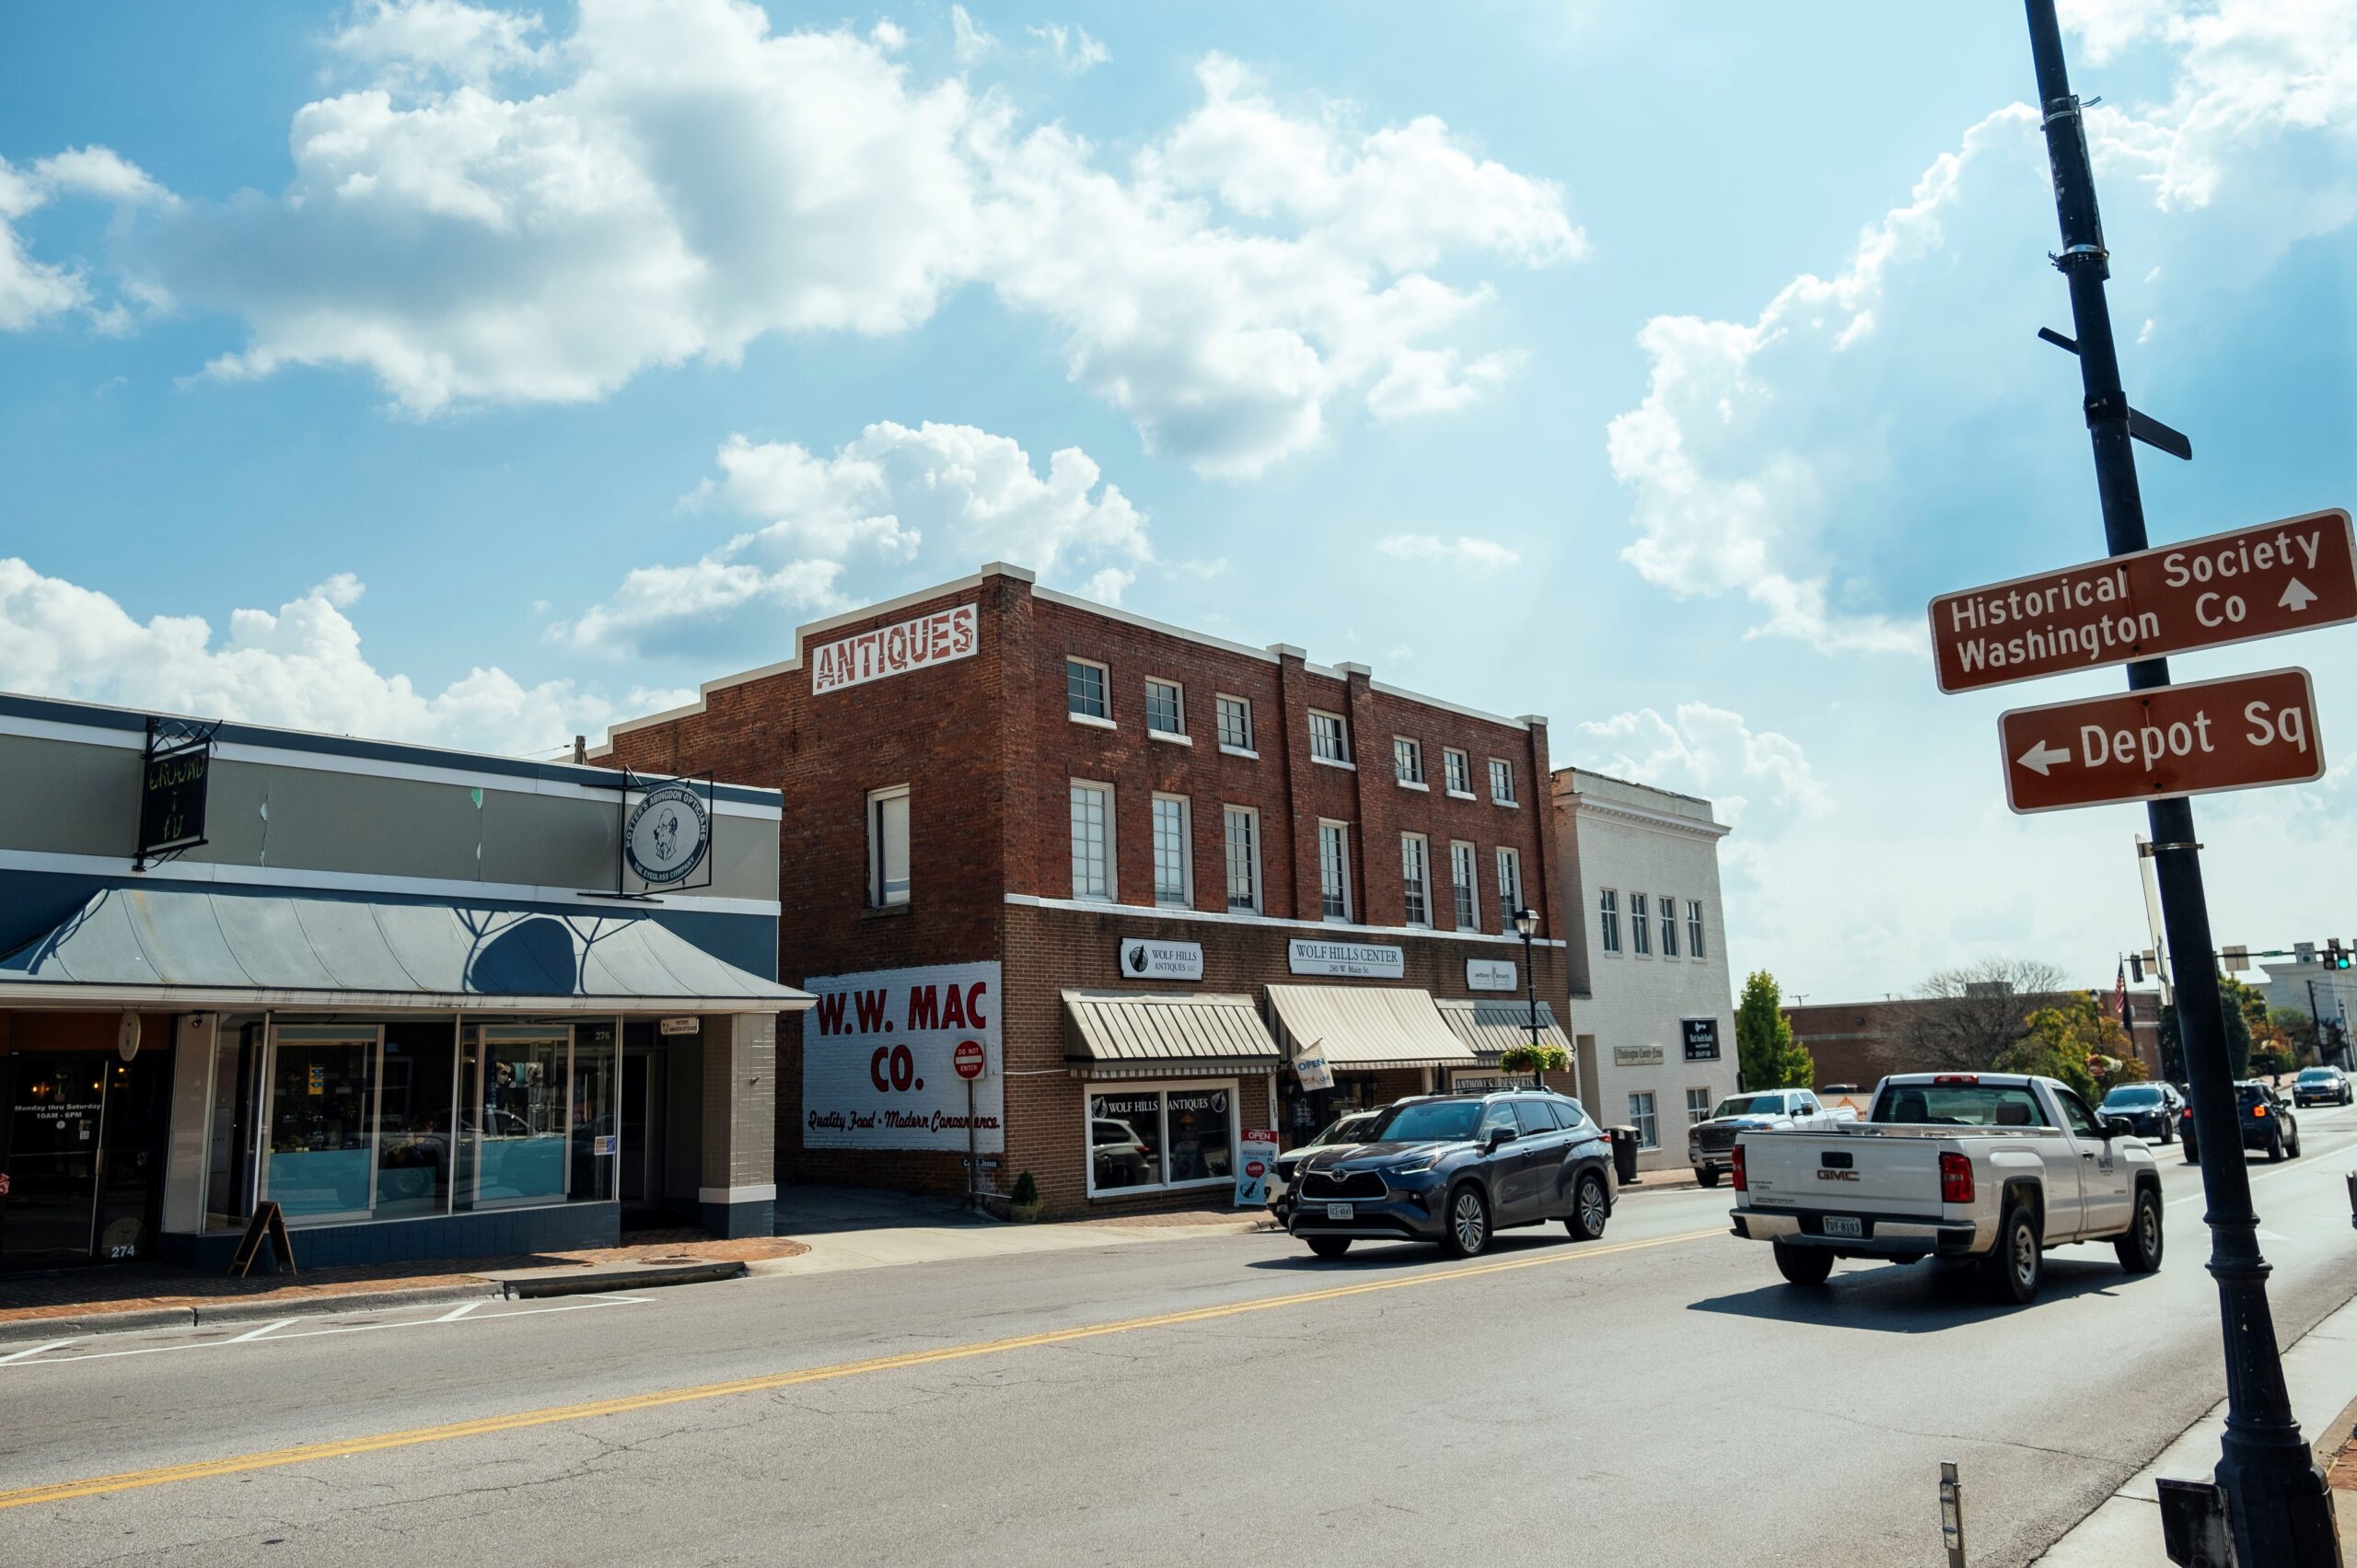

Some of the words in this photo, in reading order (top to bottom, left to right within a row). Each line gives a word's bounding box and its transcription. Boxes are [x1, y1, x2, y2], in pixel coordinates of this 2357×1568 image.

[1951, 567, 2128, 633] Historical
[2163, 530, 2320, 588] Society
[1956, 611, 2161, 673] Washington
[2195, 592, 2247, 628] Co
[816, 608, 973, 690] ANTIQUES
[2080, 709, 2215, 772] Depot
[2243, 700, 2308, 754] Sq
[626, 801, 648, 848] POTTER'S
[649, 790, 682, 807] ABINGDON
[683, 795, 707, 841] OPTICIANS
[633, 861, 643, 875] THE
[644, 869, 669, 881] EYEGLASS
[669, 857, 695, 878] COMPANY
[1152, 949, 1175, 960] WOLF
[1176, 950, 1197, 961] HILLS
[1296, 944, 1327, 958] WOLF
[1329, 947, 1359, 960] HILLS
[1360, 948, 1398, 963] CENTER
[1155, 962, 1186, 972] ANTIQUES
[1329, 964, 1339, 973] 280
[1339, 965, 1346, 973] W.
[1348, 965, 1363, 973] Main
[816, 988, 894, 1036] W.W.
[907, 981, 987, 1030] MAC
[969, 1047, 980, 1055] NOT
[870, 1044, 924, 1093] CO.
[1298, 1058, 1326, 1071] OPEN
[1457, 1078, 1493, 1089] ANTHONY'S
[1500, 1075, 1535, 1087] DESSERTS
[1109, 1102, 1132, 1113] WOLF
[1134, 1100, 1158, 1111] HILLS
[1167, 1098, 1208, 1112] ANTIQUES
[807, 1109, 846, 1132] Quality
[847, 1110, 876, 1131] Food
[884, 1109, 929, 1129] Modern
[1248, 1132, 1271, 1141] OPEN
[1817, 1169, 1860, 1181] GMC
[111, 1245, 134, 1258] 274
